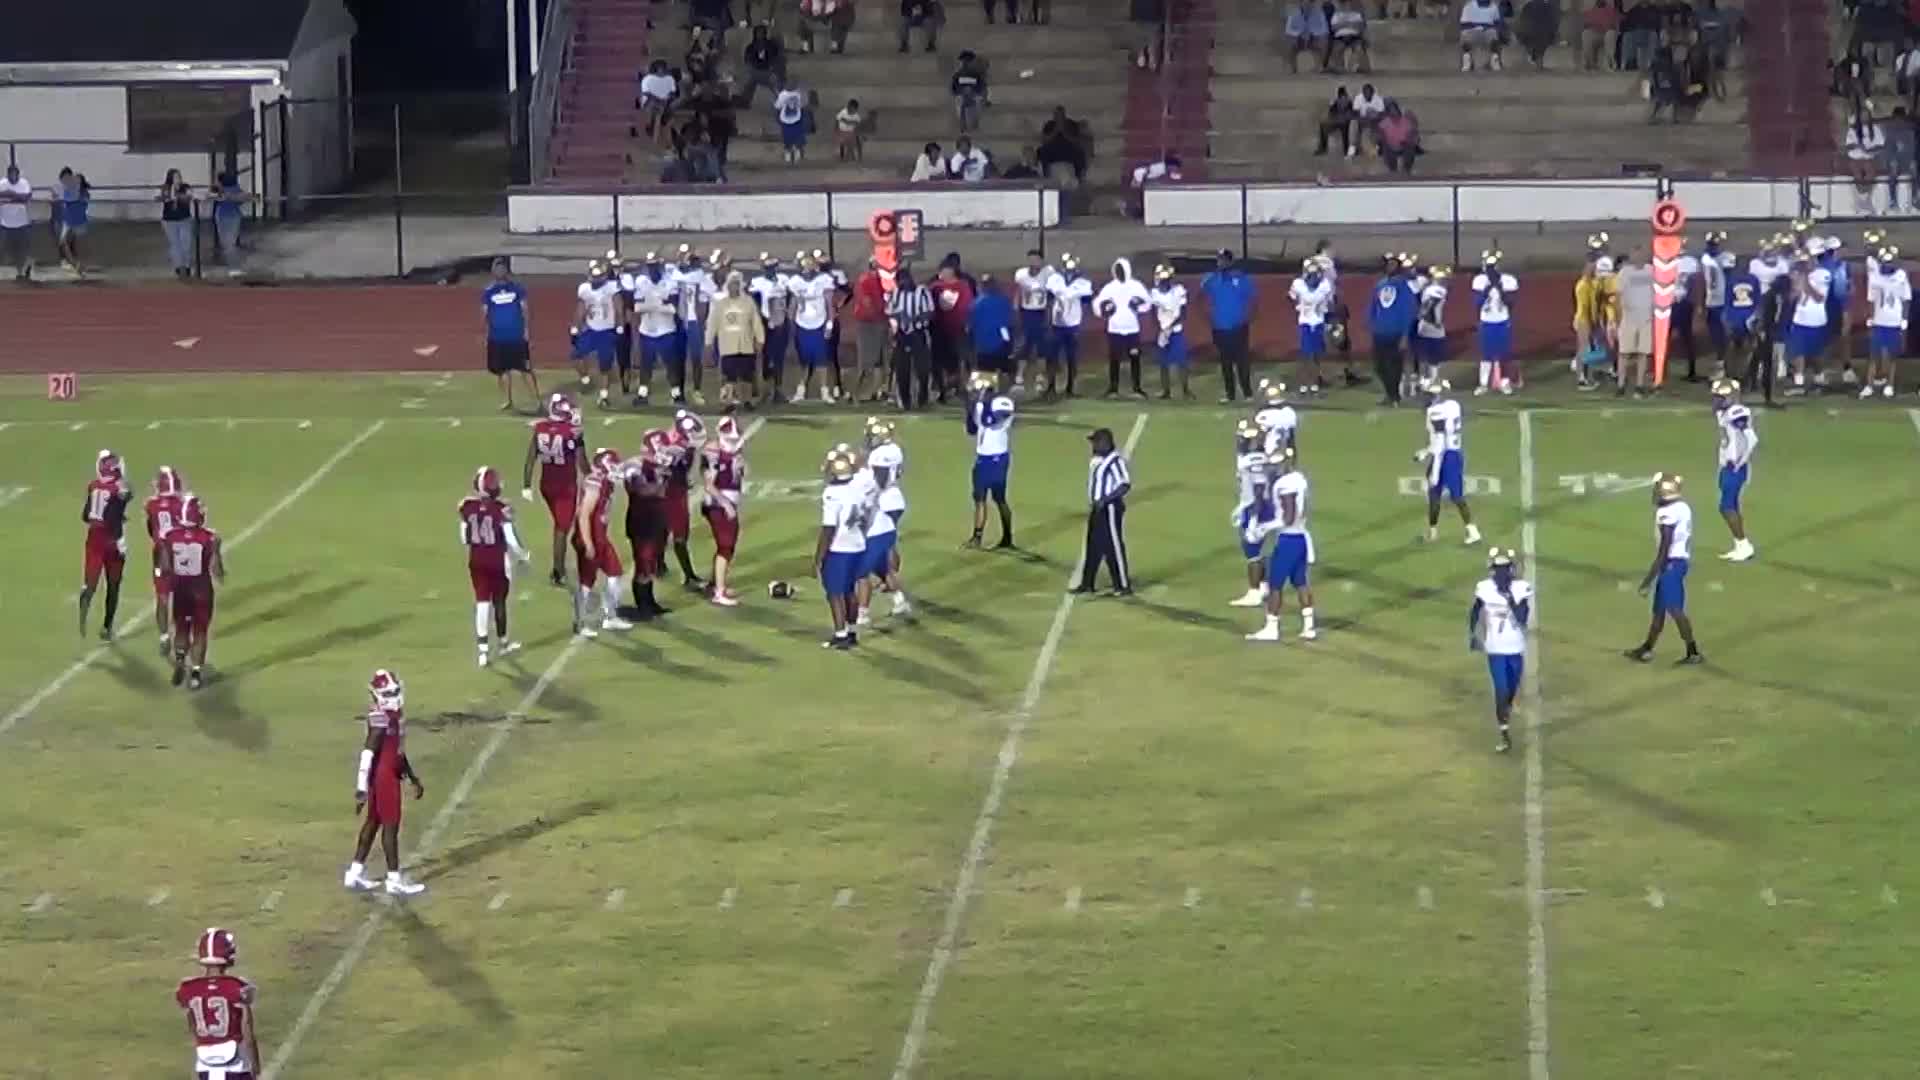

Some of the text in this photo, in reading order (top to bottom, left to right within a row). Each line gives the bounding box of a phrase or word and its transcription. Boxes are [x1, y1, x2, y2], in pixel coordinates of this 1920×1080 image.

[51, 376, 74, 398] 20
[468, 513, 496, 545] 14
[189, 996, 230, 1038] 13
